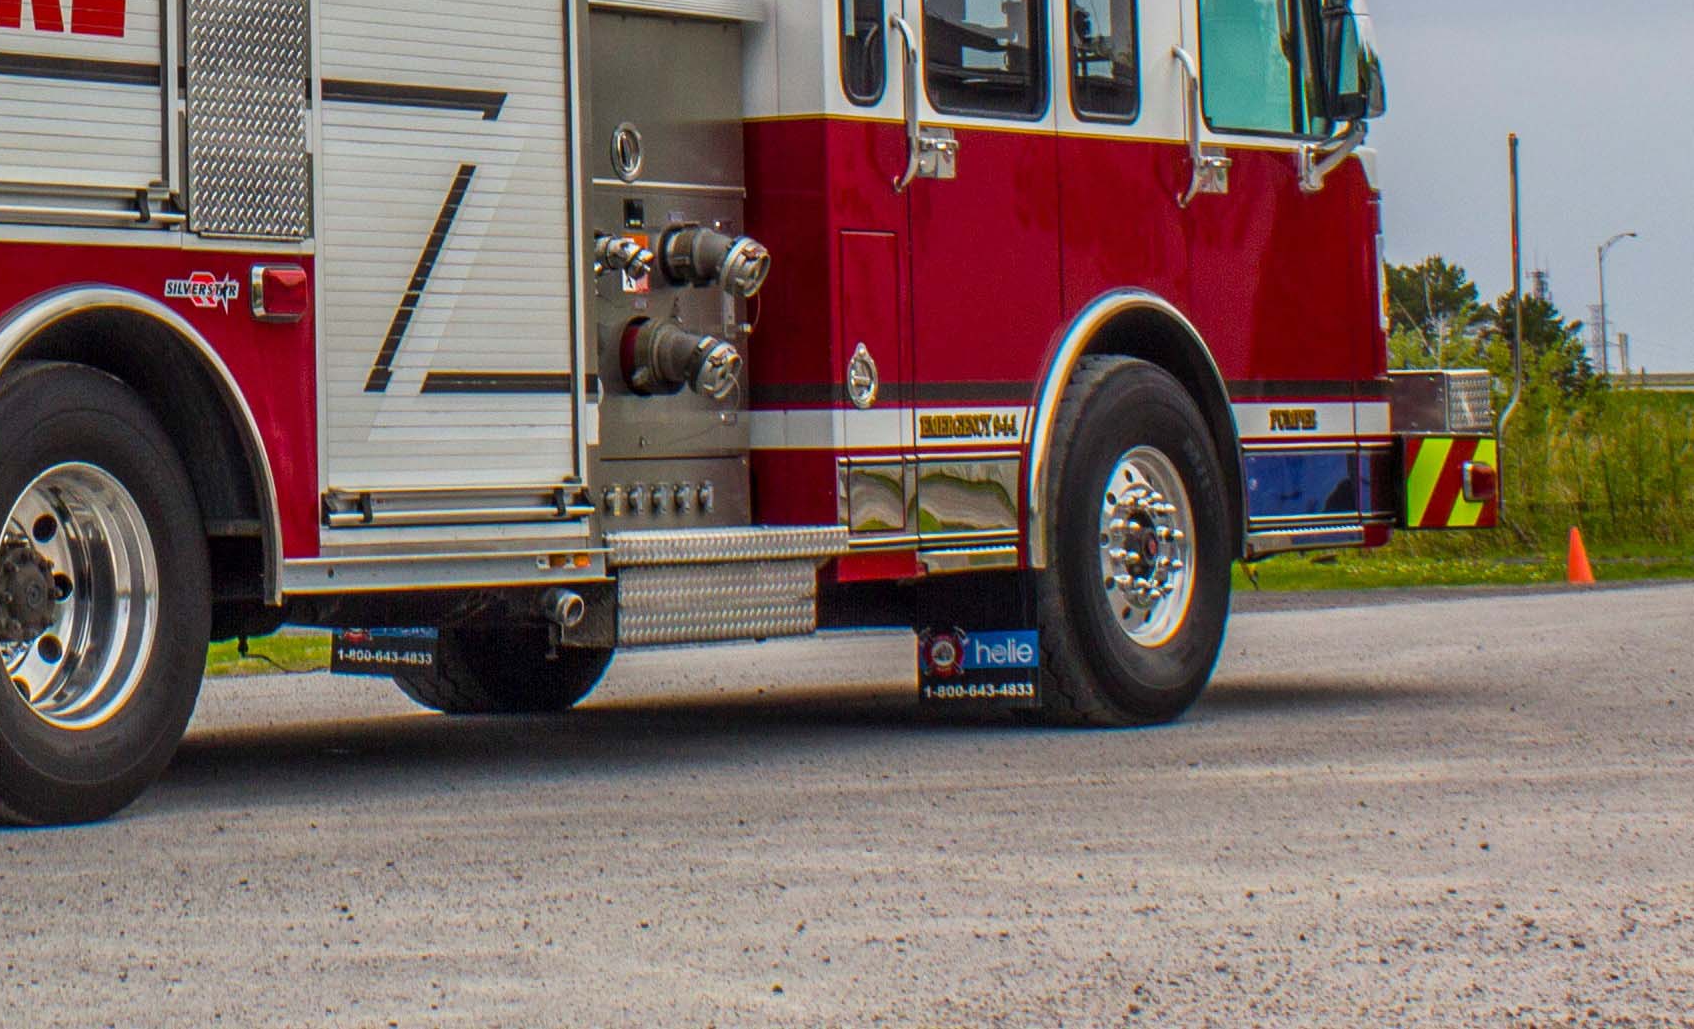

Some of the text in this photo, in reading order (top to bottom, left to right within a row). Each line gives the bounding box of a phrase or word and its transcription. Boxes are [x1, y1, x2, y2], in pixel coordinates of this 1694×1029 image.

[165, 278, 239, 300] SILVERSTAR
[920, 414, 992, 438] EMERGENCY
[337, 647, 433, 665] 1-800-643-4833
[975, 636, 1034, 664] helie
[924, 683, 1034, 699] 1-800-643-4833
